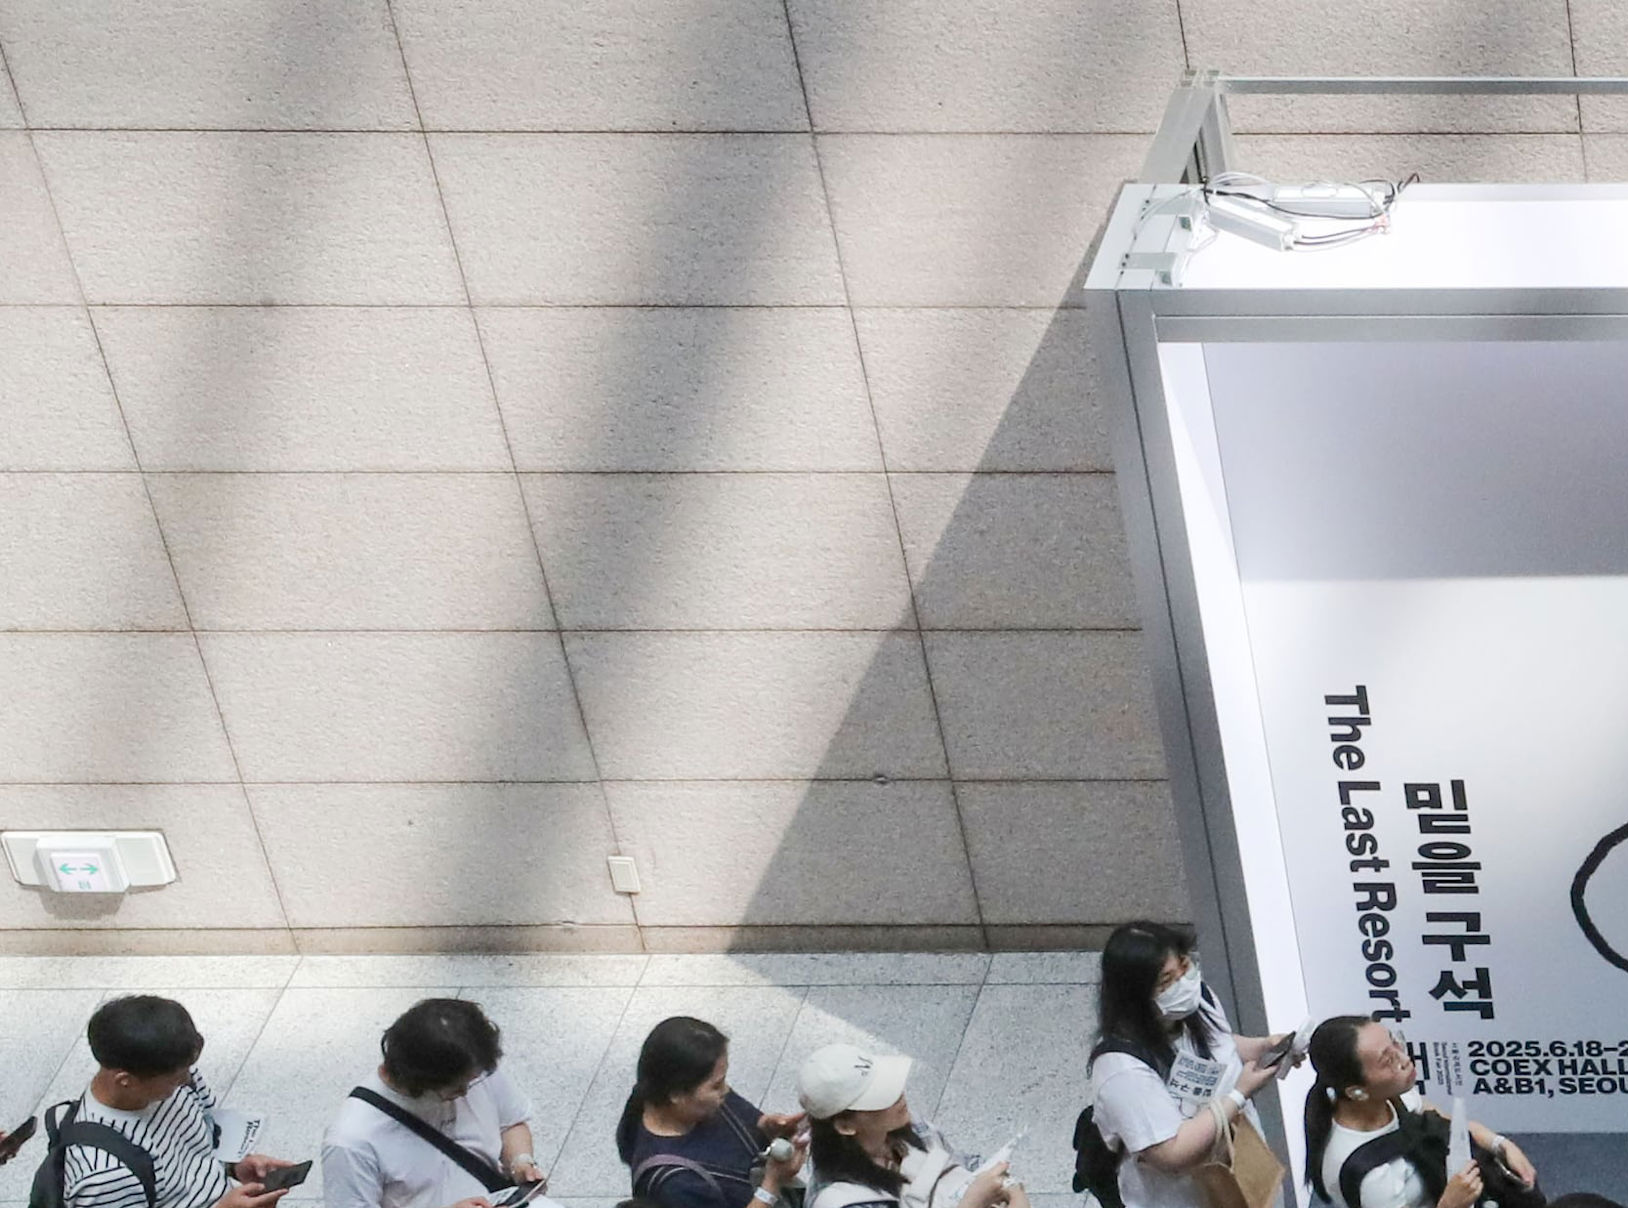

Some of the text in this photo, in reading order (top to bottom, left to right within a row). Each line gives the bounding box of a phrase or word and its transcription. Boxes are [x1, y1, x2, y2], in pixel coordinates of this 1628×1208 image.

[1325, 685, 1411, 1023] The Last Resort
[1404, 779, 1495, 1020] 믿을 구석
[1470, 1059, 1553, 1076] COEX
[1473, 1077, 1555, 1098] A&B1,
